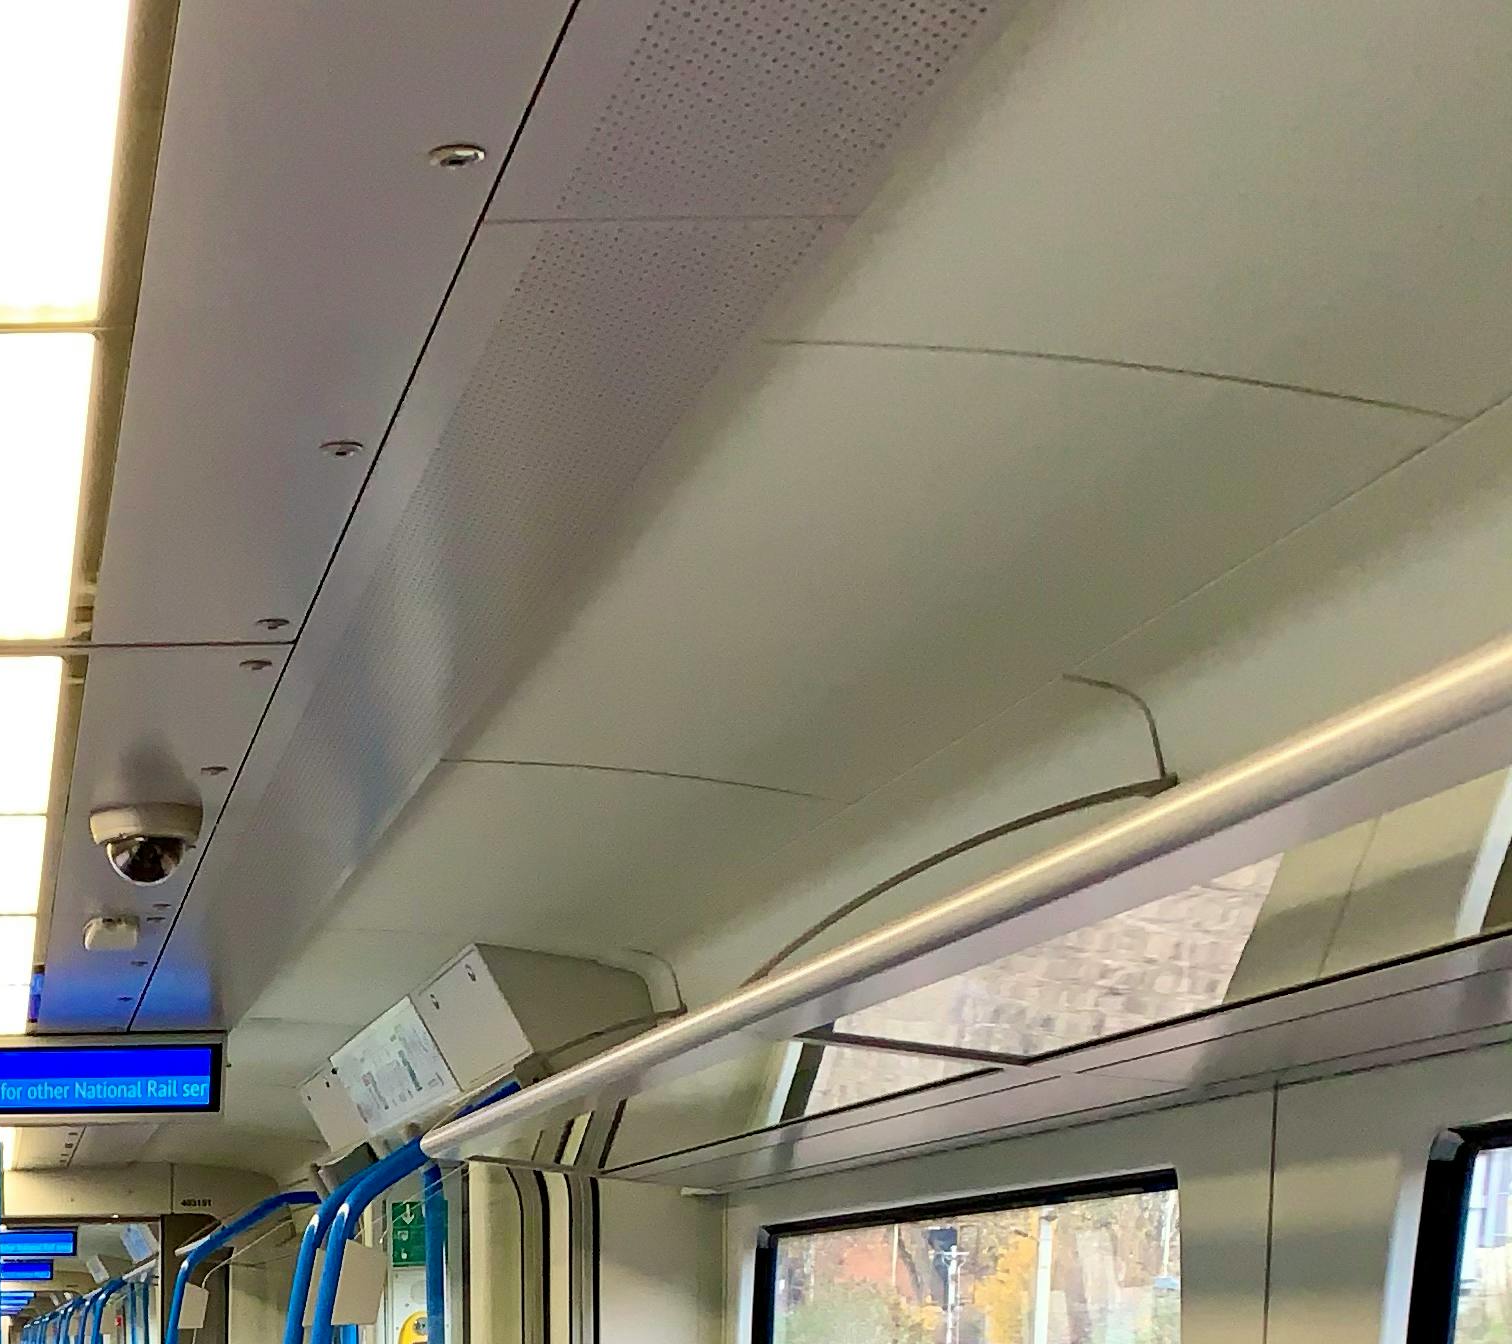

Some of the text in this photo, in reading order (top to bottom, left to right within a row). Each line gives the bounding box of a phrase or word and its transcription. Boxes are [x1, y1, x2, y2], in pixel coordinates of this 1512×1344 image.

[1, 1082, 23, 1100] for
[28, 1081, 71, 1100] other
[74, 1080, 143, 1099] National
[148, 1079, 178, 1098] Rail
[182, 1082, 208, 1098] ser
